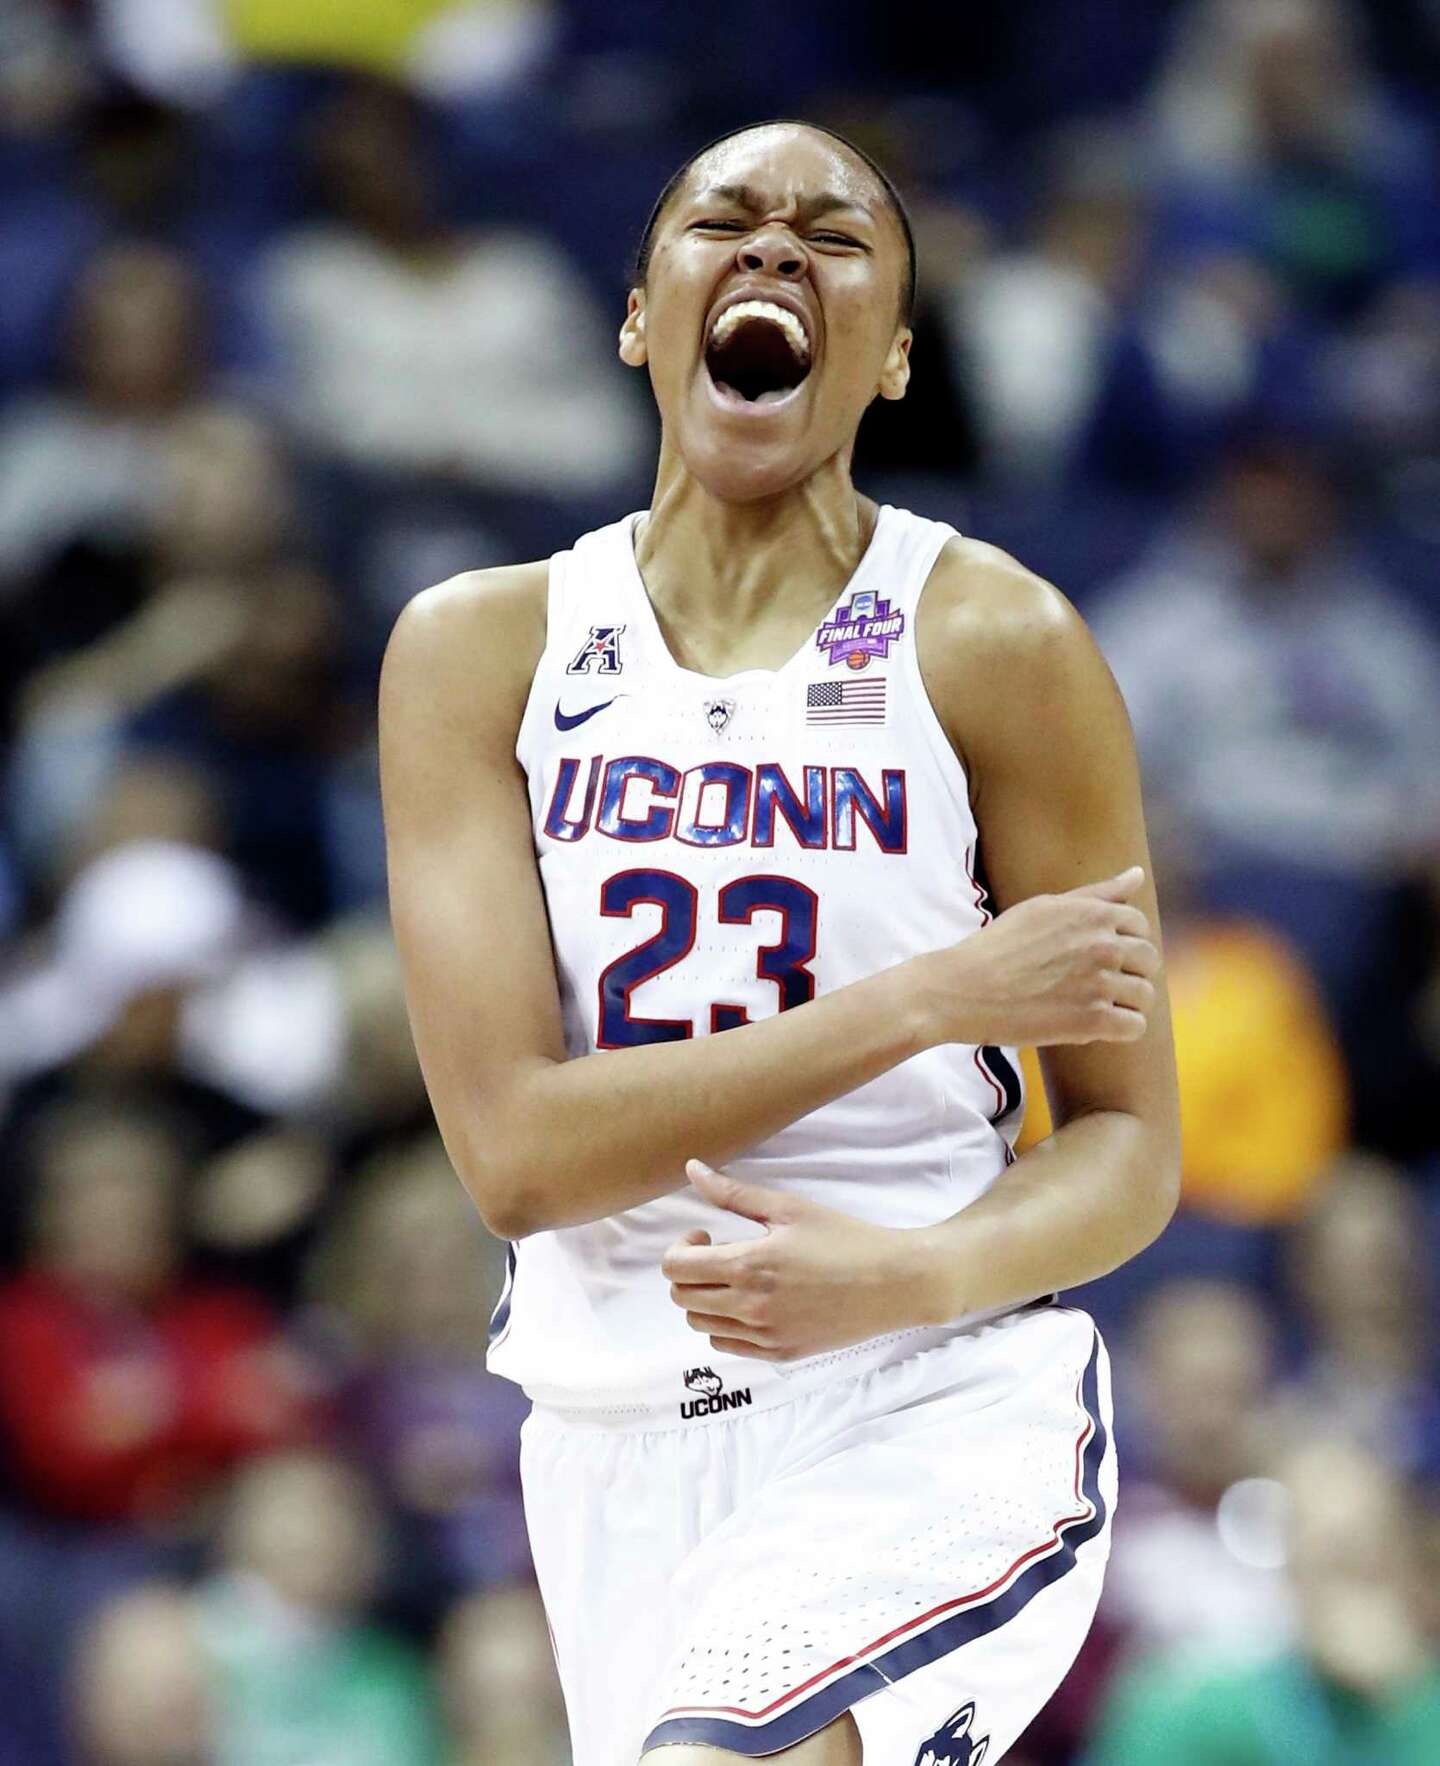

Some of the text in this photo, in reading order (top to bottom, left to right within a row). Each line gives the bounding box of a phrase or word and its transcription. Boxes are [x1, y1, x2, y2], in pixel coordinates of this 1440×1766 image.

[819, 618, 902, 644] FINAL FOUR
[543, 755, 907, 854] UCONN
[596, 868, 819, 1050] 23
[680, 1387, 752, 1419] UCONN
